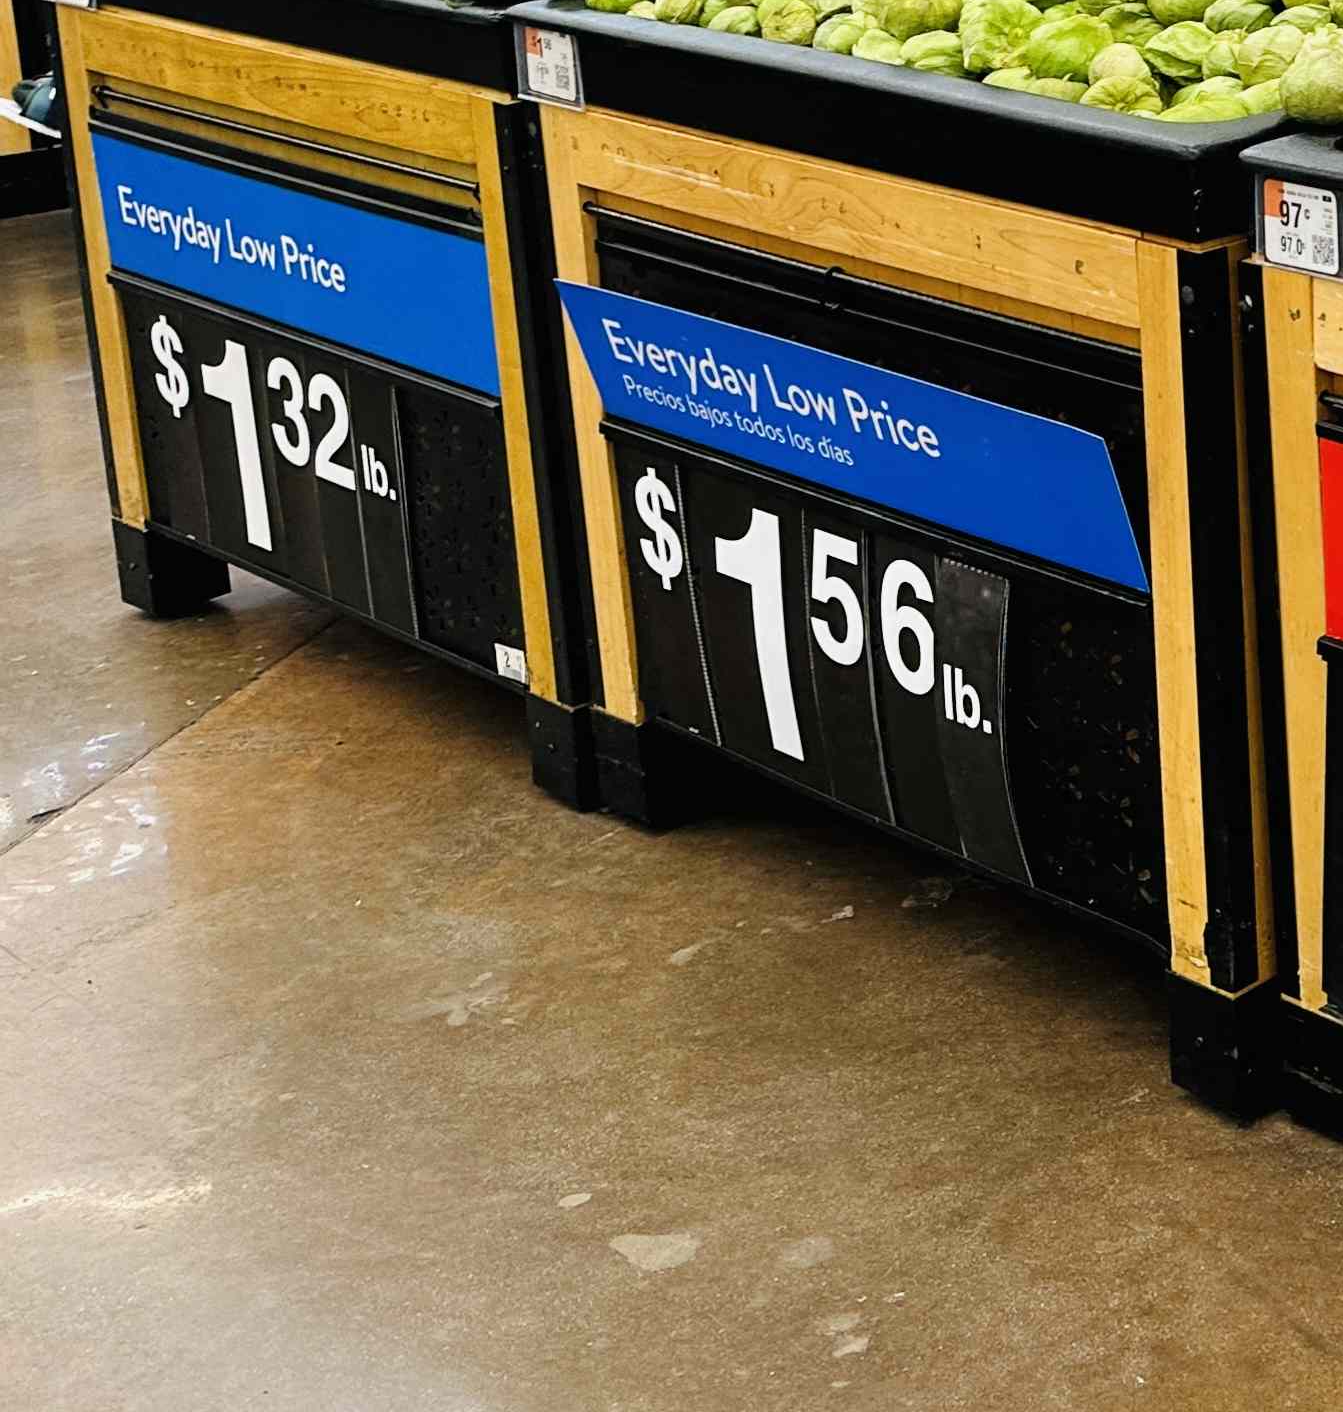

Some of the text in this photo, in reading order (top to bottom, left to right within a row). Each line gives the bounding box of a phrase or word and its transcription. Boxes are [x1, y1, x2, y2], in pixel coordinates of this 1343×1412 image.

[117, 184, 347, 293] Everyday Low Price
[601, 318, 941, 458] Everyday Low Price
[622, 373, 854, 466] Precios bajos todos los días
[361, 443, 397, 501] lb.
[943, 663, 992, 734] lb.
